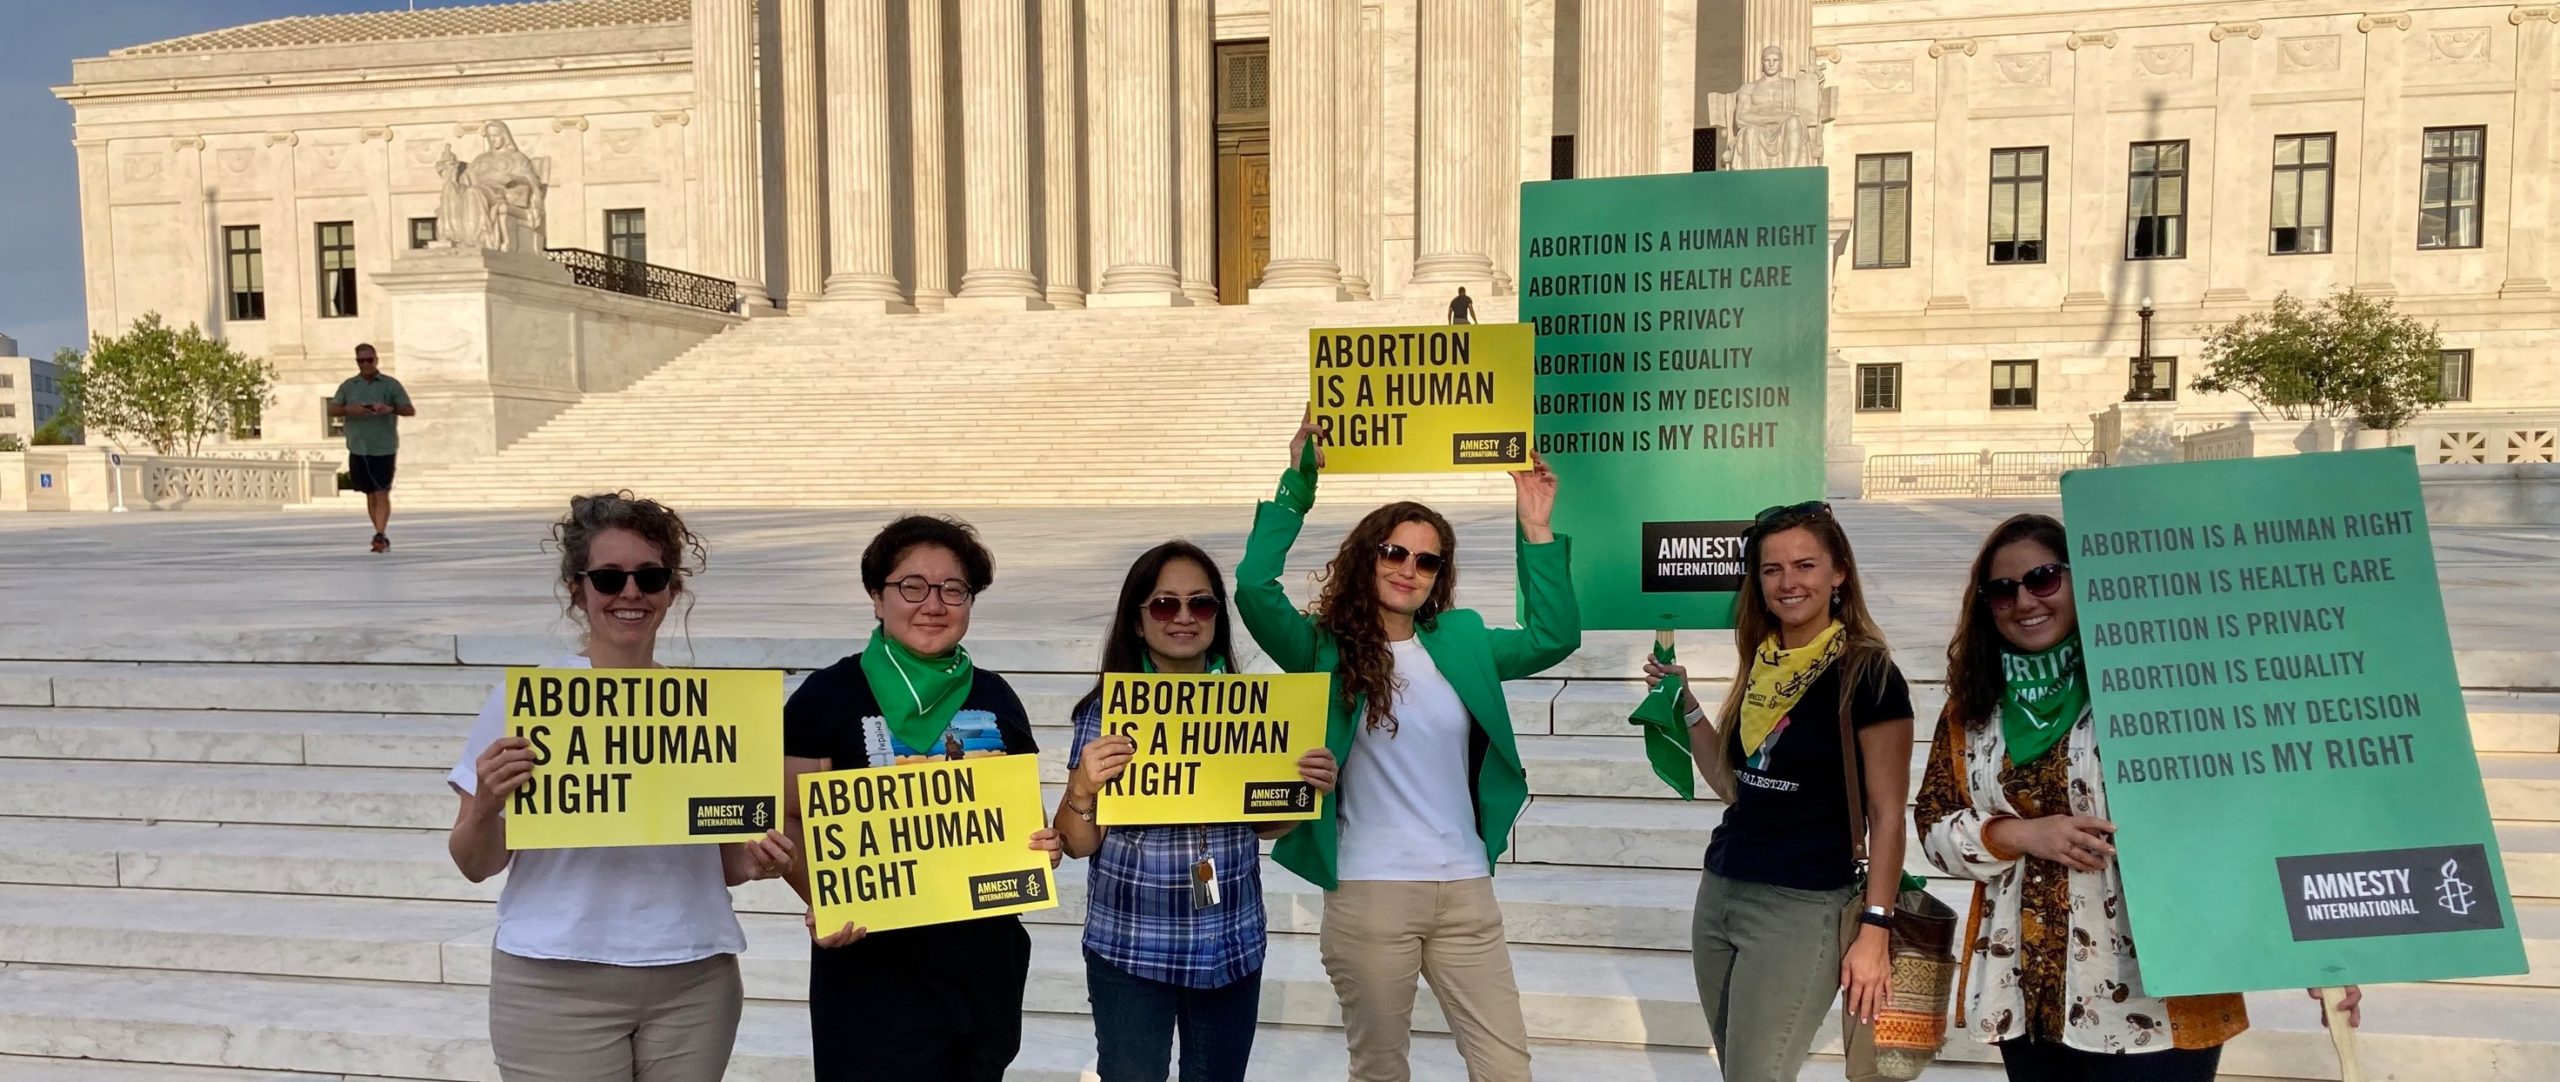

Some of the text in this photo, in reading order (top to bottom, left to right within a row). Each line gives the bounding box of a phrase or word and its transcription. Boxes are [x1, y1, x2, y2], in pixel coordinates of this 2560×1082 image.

[1529, 224, 1818, 258] ABORTION IS A HUMAN RIGHT
[1528, 265, 1792, 297] ABORTION IS HEALTH CARE
[1633, 311, 1651, 333] IS
[1659, 307, 1744, 331] PRIVACY
[1314, 331, 1470, 369] ABORTION
[1633, 350, 1651, 373] IS
[1658, 347, 1752, 372] EQUALITY
[1317, 371, 1494, 408] IS A HUMAN
[1633, 390, 1651, 412] IS
[1658, 388, 1687, 411] MY
[1694, 385, 1790, 410] DECISION
[1316, 413, 1408, 447] RIGHT
[1459, 439, 1500, 451] AMNESTY
[1633, 430, 1650, 452] IS
[1658, 424, 1694, 451] MY
[1703, 421, 1778, 449] RIGHT
[1459, 450, 1500, 458] INTERNATIONAL
[1658, 536, 1749, 559] AMNESTY
[2081, 510, 2413, 557] ABORTION IS A HUMAN RIGHT
[1658, 562, 1748, 576] INTERNATIONAL
[2087, 557, 2395, 602] ABORTION IS HEALTH CARE
[2094, 606, 2346, 647] ABORTION IS PRIVACY
[2102, 651, 2364, 692] ABORTION IS EQUALITY
[512, 676, 708, 717] ABORTION
[1108, 680, 1269, 715] ABORTION
[2109, 693, 2421, 738] ABORTION IS MY DECISION
[566, 725, 590, 765] A
[605, 724, 737, 765] HUMAN
[1149, 721, 1168, 755] A
[1180, 720, 1289, 755] HUMAN
[2117, 734, 2414, 784] ABORTION IS MY RIGHT
[514, 773, 632, 815] RIGHT
[808, 767, 976, 818] ABORTION
[1250, 799, 1289, 807] INTERNATIONAL
[1251, 788, 1290, 800] AMNESTY
[697, 804, 744, 818] AMNESTY
[697, 818, 744, 827] INTERNATIONAL
[813, 807, 1006, 862] IS A HUMAN
[816, 859, 918, 907] RIGHT
[977, 878, 1018, 894] AMNESTY
[978, 890, 1020, 903] INTERNATIONAL
[2303, 868, 2410, 900] AMNESTY
[2306, 898, 2420, 921] INTERNATIONAL
